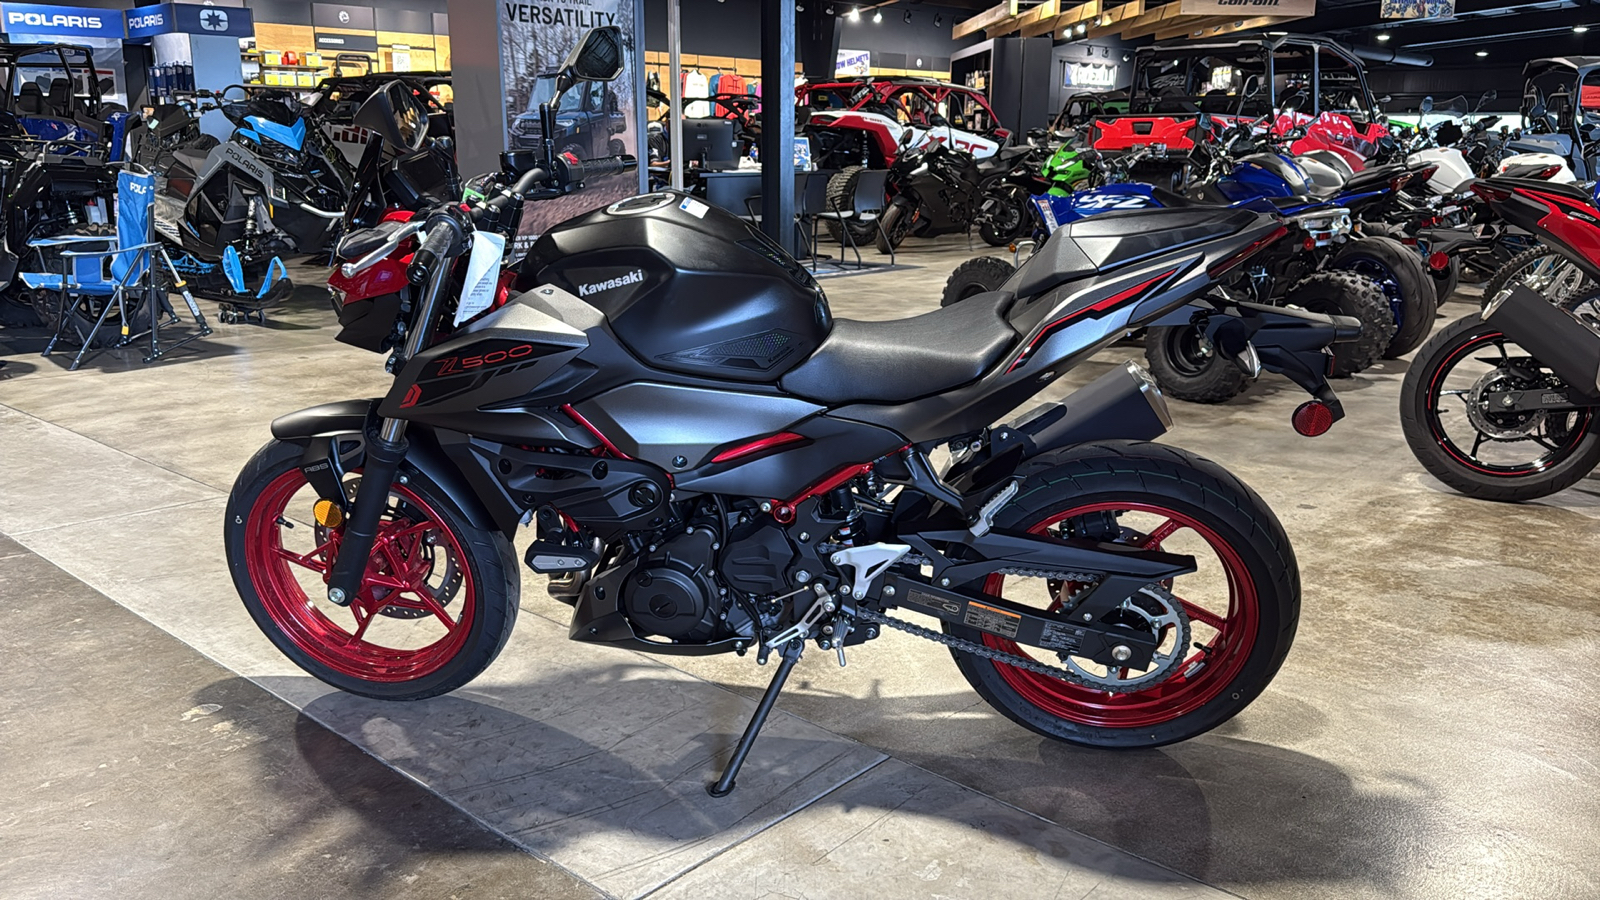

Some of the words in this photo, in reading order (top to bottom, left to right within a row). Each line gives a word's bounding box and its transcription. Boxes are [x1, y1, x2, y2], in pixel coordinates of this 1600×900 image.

[8, 12, 102, 28] POLARIS
[128, 13, 164, 29] POLARIS
[505, 3, 616, 28] VERSATILITY
[225, 147, 265, 179] POLARIS
[578, 269, 644, 297] Kawasaki
[433, 344, 533, 377] Z500
[304, 462, 329, 474] ABS
